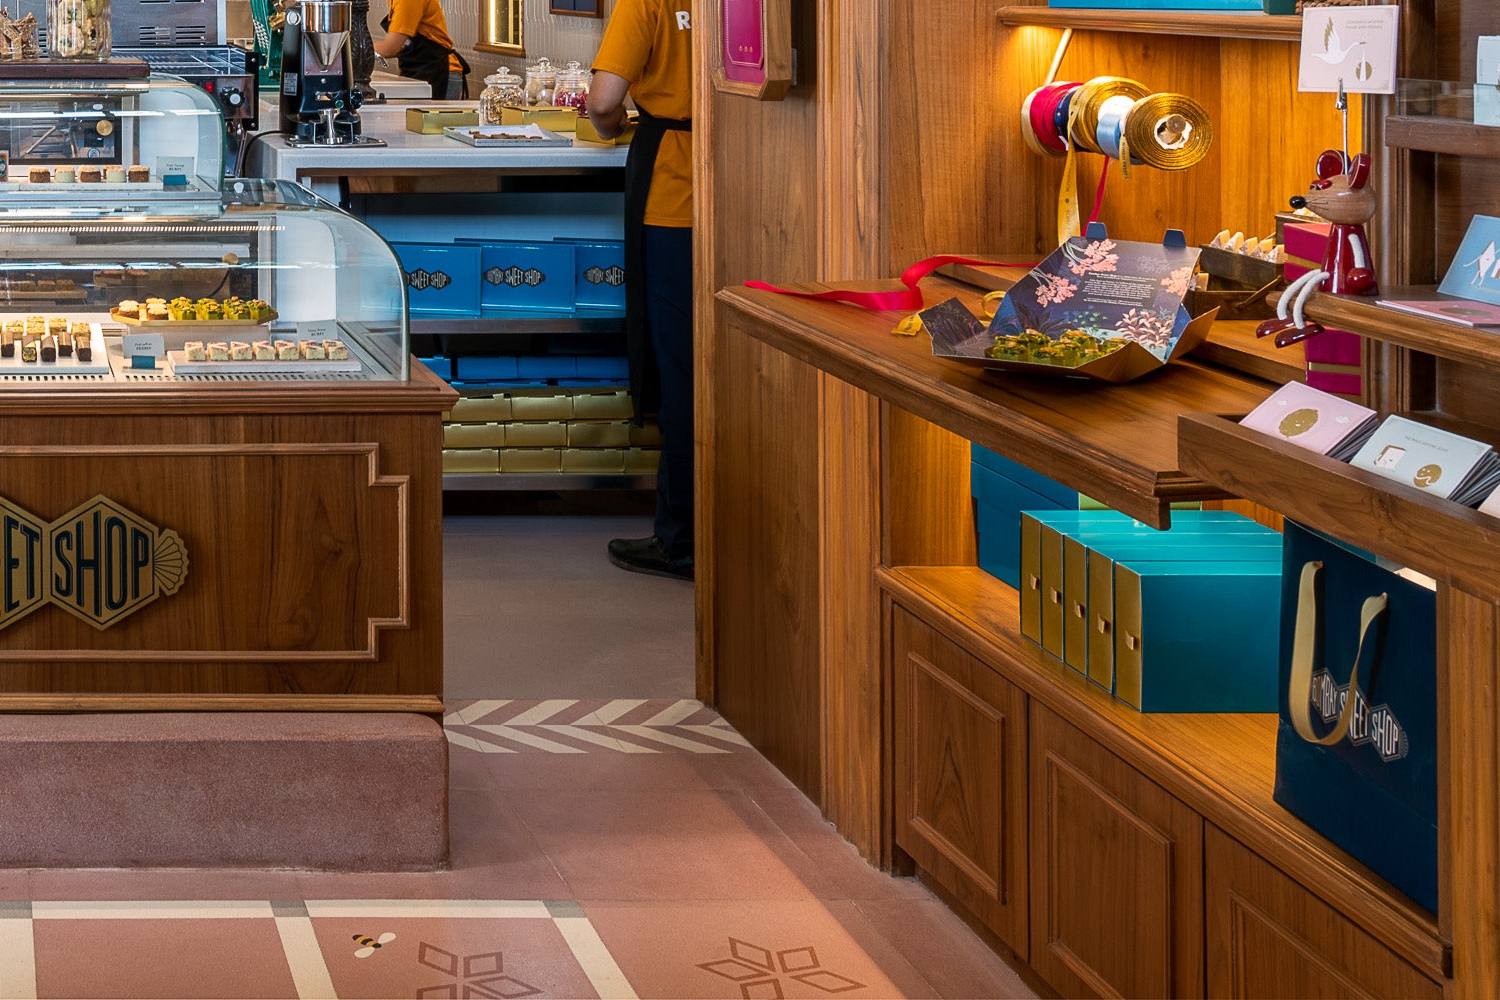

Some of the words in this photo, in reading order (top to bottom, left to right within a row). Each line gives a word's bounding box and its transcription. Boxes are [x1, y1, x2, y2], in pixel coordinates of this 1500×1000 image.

[675, 10, 692, 30] R
[411, 268, 430, 290] SWEET
[430, 269, 448, 289] SHOP
[504, 265, 524, 288] SWEET
[524, 267, 541, 286] SHOP
[605, 265, 625, 287] SWEET
[54, 510, 150, 617] SHOP
[1371, 709, 1399, 756] SHOP
